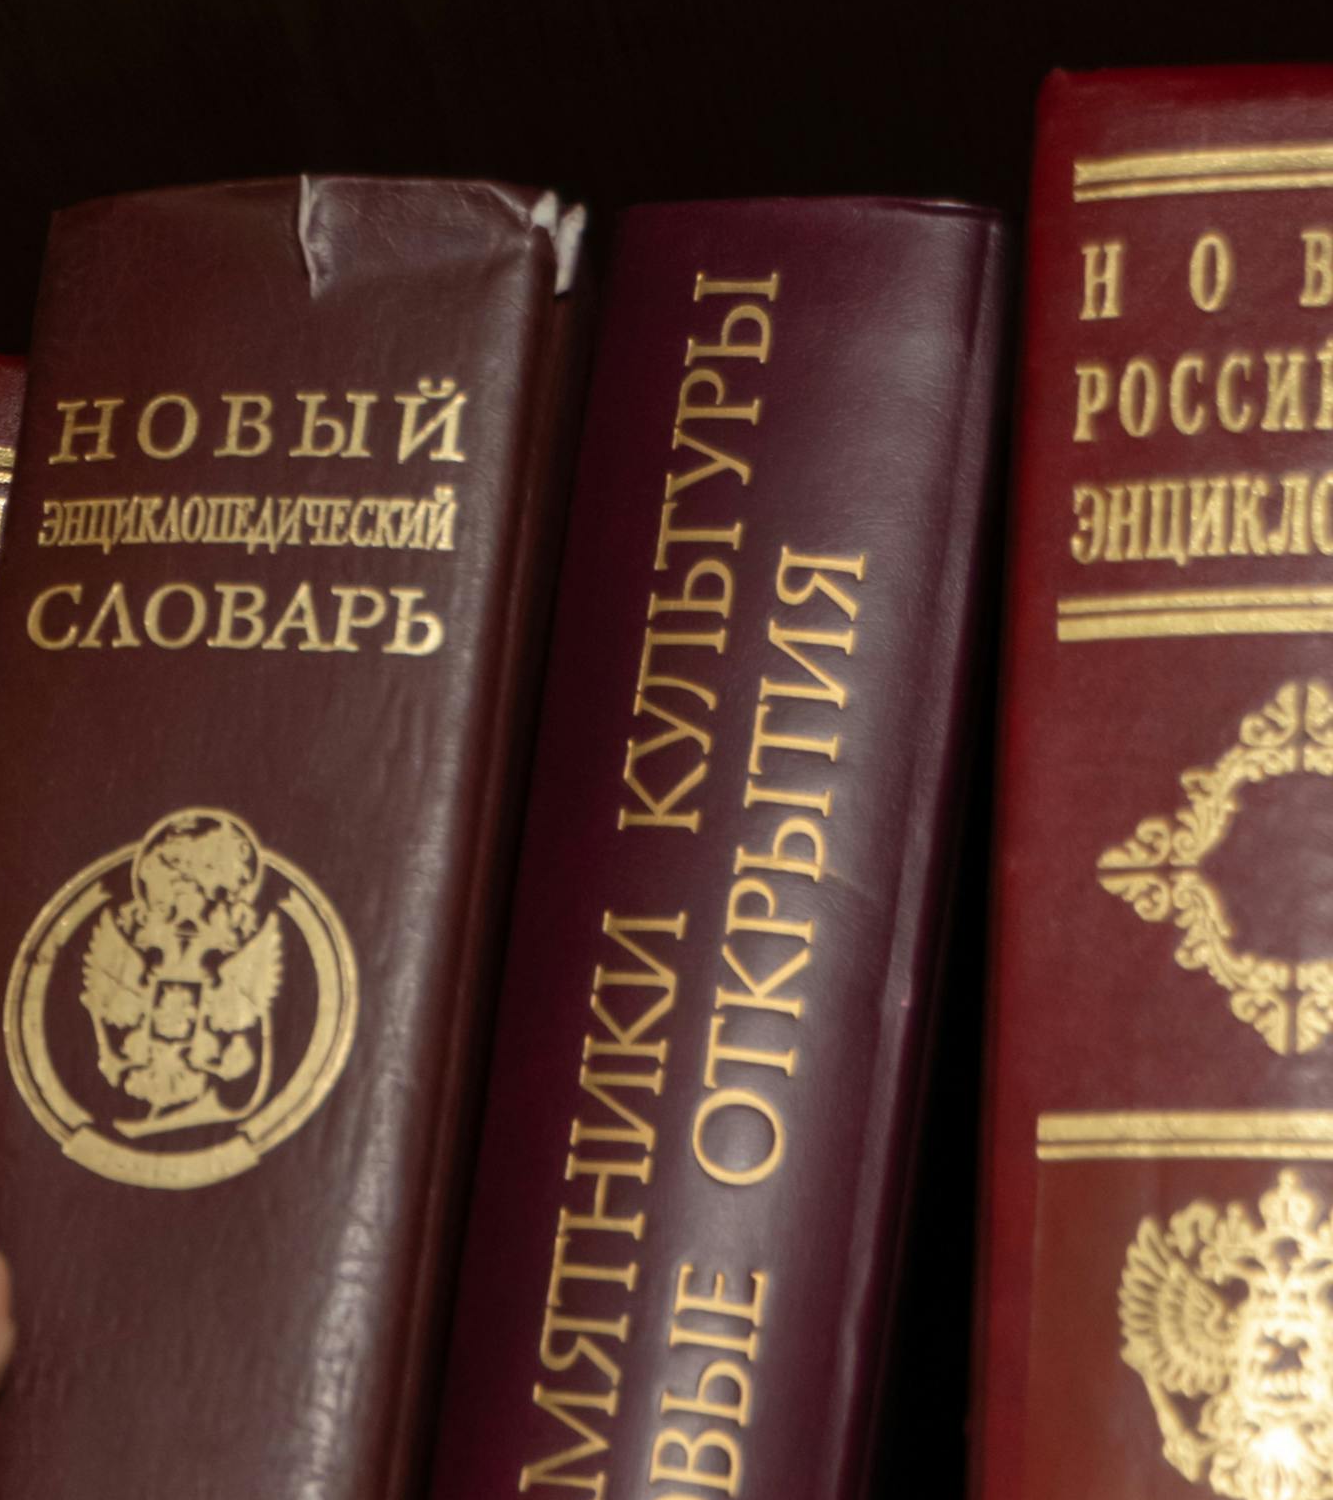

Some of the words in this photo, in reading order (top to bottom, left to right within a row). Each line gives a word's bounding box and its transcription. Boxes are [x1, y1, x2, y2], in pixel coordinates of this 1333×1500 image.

[48, 378, 469, 466] НОВЫЙ
[37, 487, 456, 557] ЭНЦИКЛОПЕДИЧЕСКИЙ
[615, 269, 781, 834] КУЛЬТУРЫ
[26, 579, 445, 656] СЛОВАРЬ
[690, 544, 868, 1189] ОТКРЫТИЯ
